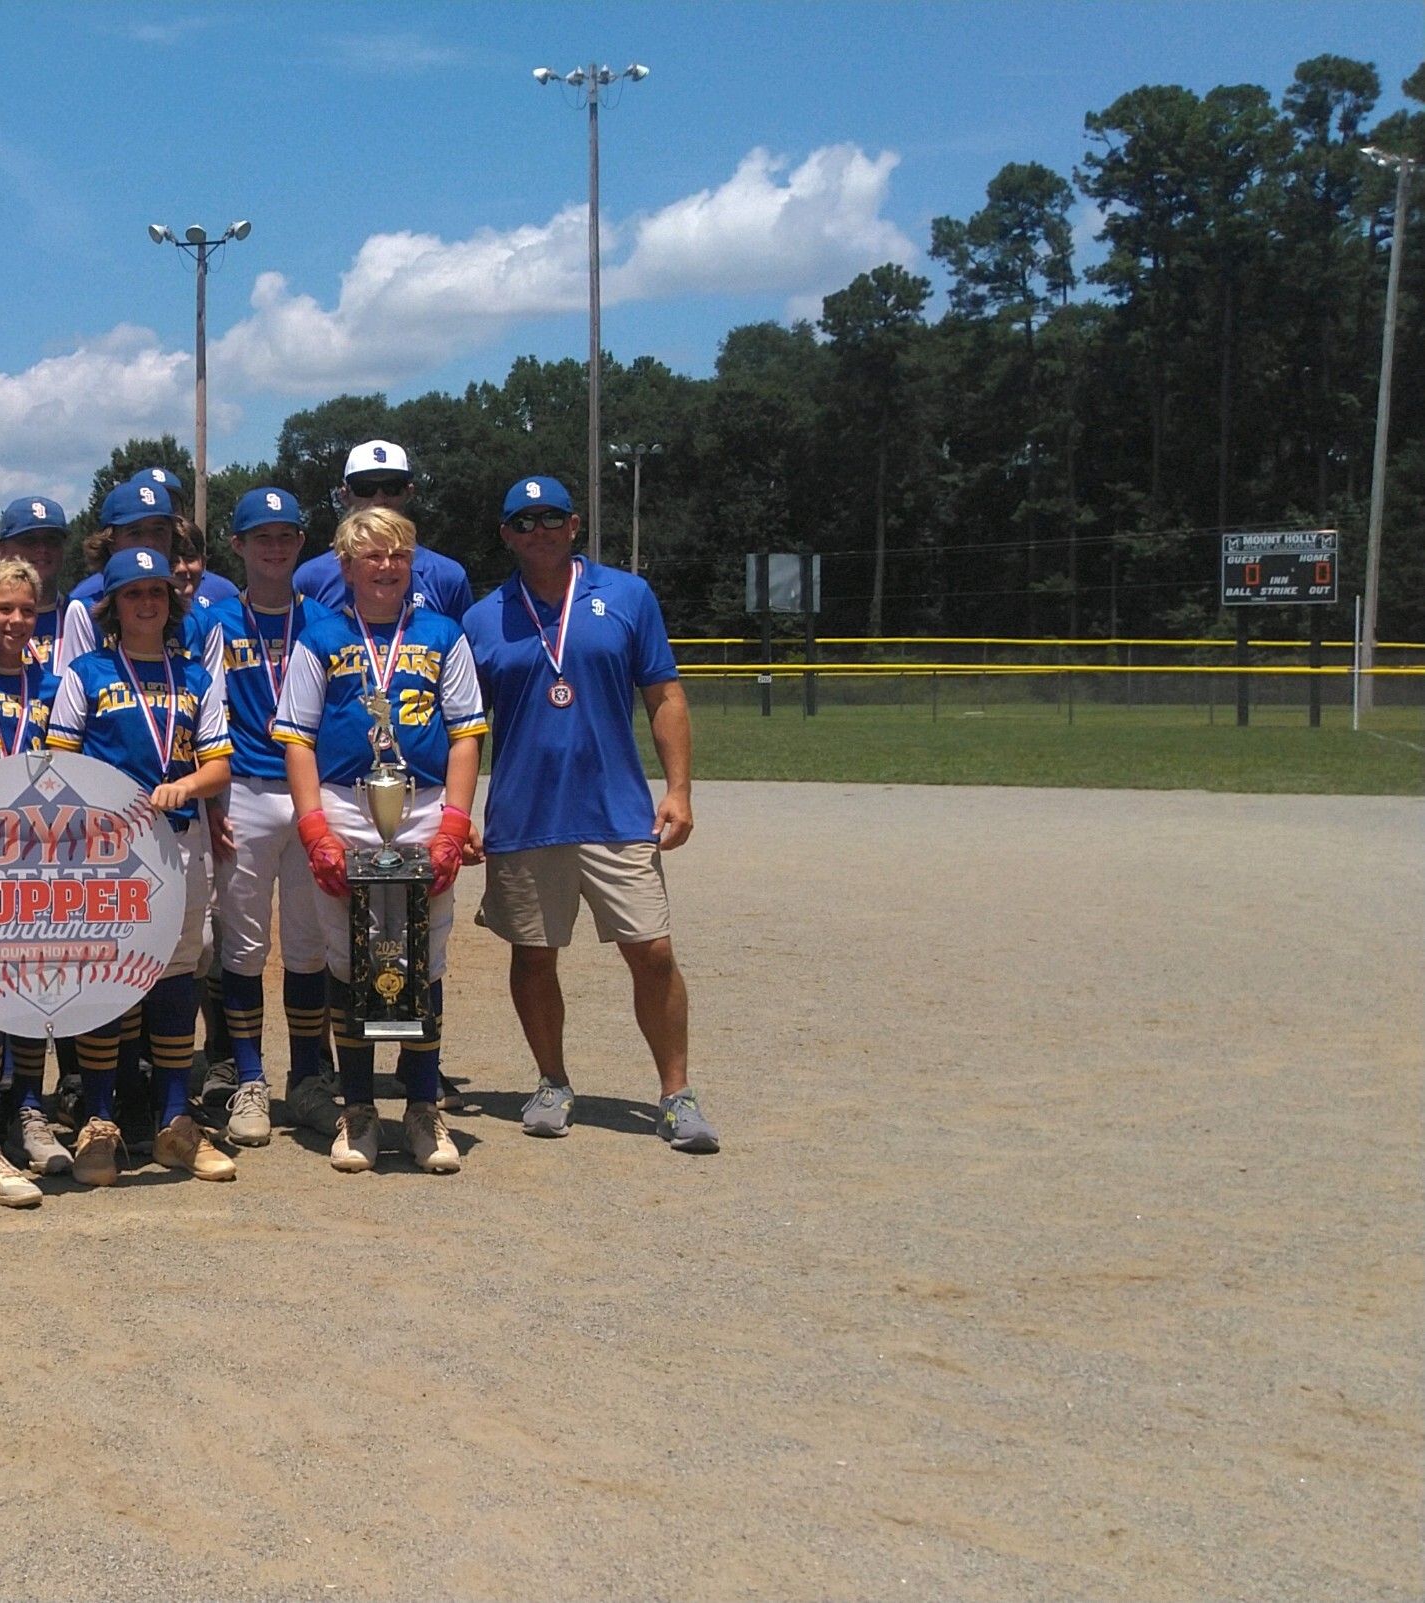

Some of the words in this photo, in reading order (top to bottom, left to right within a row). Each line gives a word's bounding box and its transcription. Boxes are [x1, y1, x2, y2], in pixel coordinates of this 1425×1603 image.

[1242, 535, 1282, 545] MOUNT
[1284, 534, 1318, 543] HOLLY
[1227, 555, 1262, 564] GUEST
[1299, 554, 1331, 562] HOME
[1245, 564, 1260, 586] 0
[1315, 562, 1330, 584] 0
[1269, 576, 1289, 585] INN
[1225, 588, 1252, 596] BALL
[1260, 586, 1299, 596] STRIKE
[1309, 586, 1332, 595] OUT
